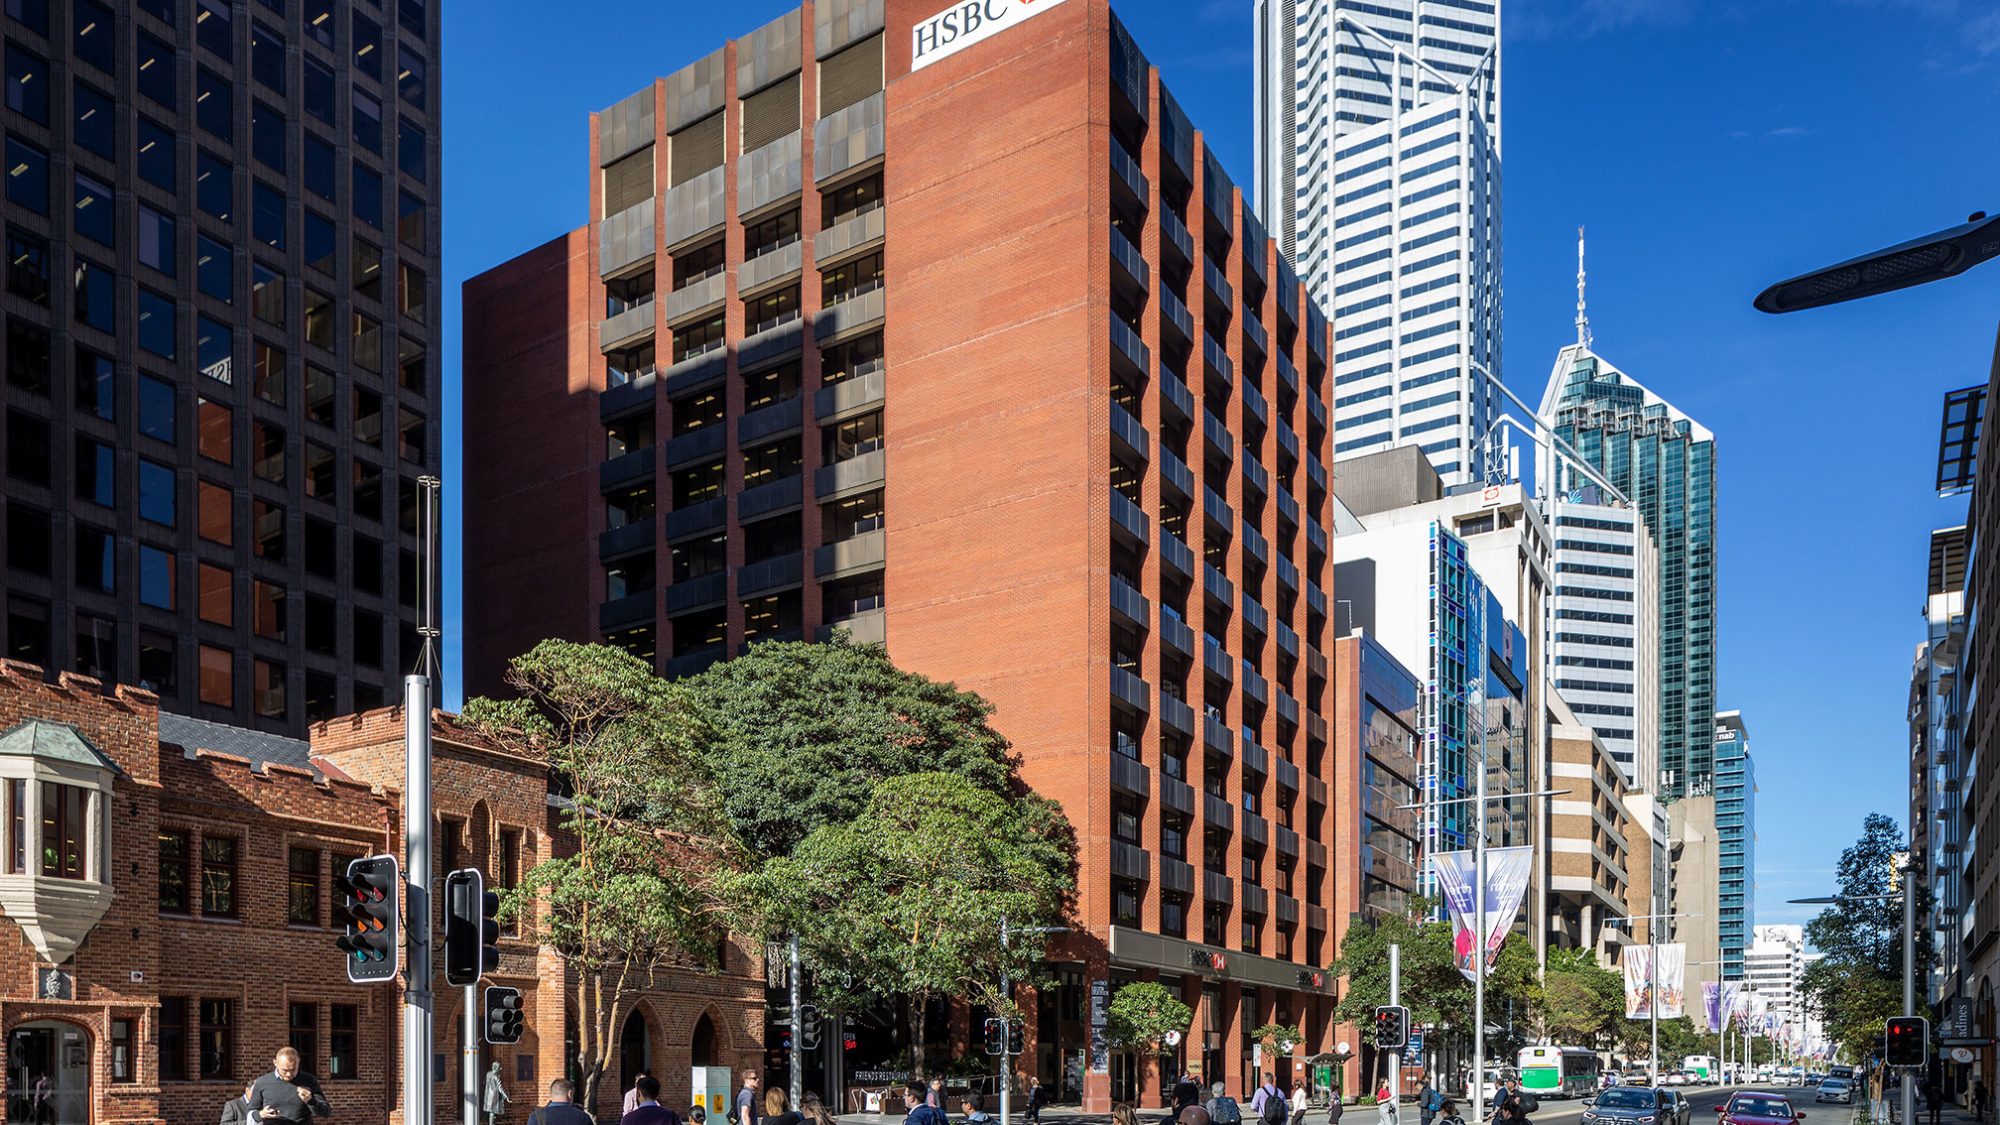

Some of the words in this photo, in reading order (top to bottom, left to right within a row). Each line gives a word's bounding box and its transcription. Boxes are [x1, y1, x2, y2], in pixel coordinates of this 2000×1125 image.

[915, 0, 1008, 59] HSBC
[1719, 731, 1735, 740] nab
[879, 1071, 910, 1081] RESTAURANT
